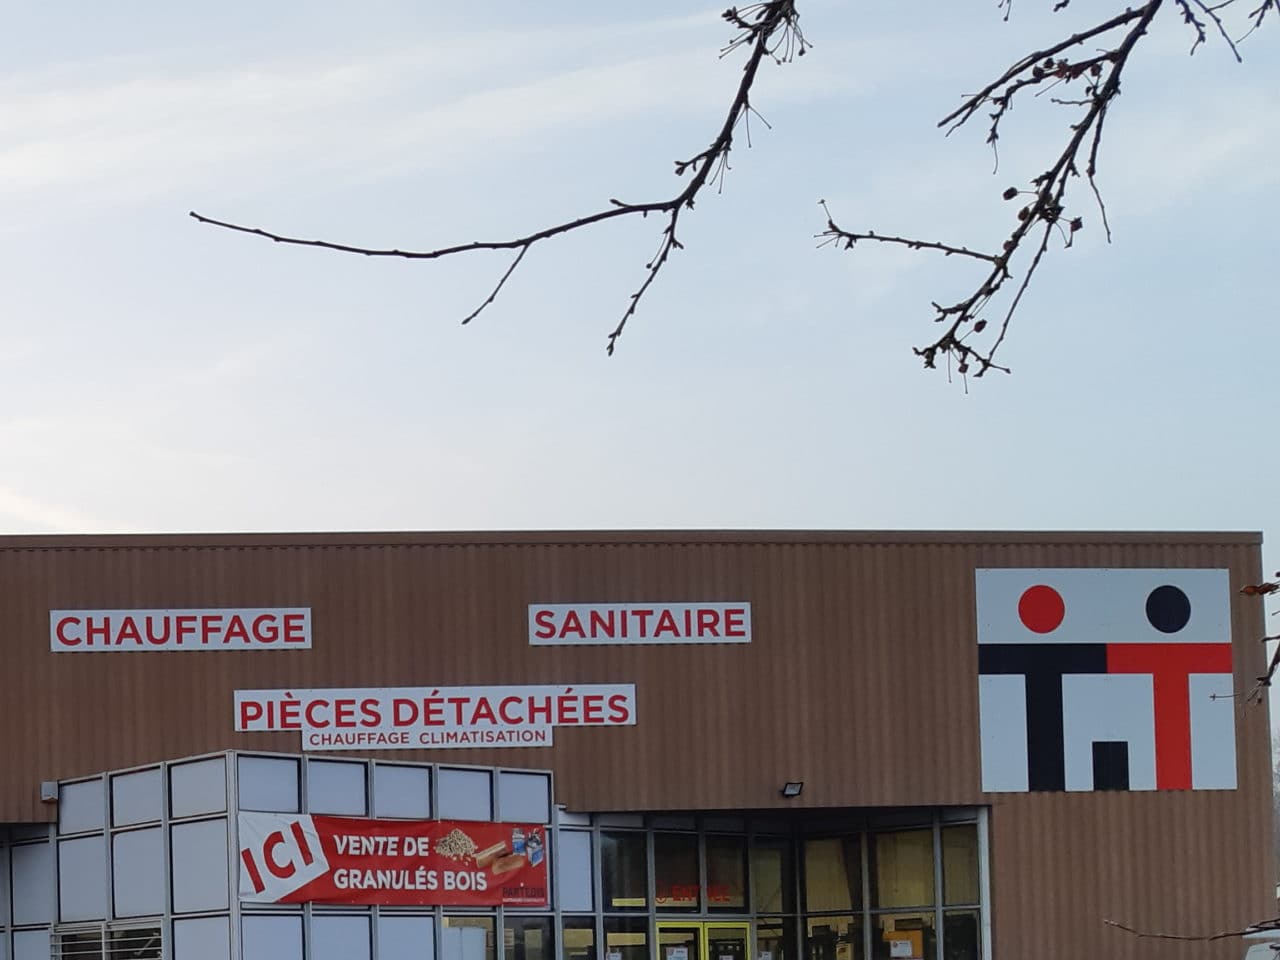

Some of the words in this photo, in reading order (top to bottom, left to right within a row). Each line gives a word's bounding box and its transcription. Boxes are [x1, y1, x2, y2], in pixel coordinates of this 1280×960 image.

[56, 614, 305, 646] CHAUFFAGE
[535, 609, 746, 640] SANITAIRE
[240, 691, 380, 730] PIÈCES
[393, 687, 629, 727] DÉTACHÉES
[309, 731, 410, 745] CHAUFFAGE
[419, 729, 546, 744] CLIMATISATION
[241, 821, 313, 894] ICI
[333, 834, 399, 856] VENTE
[403, 837, 429, 857] DE
[333, 866, 437, 890] GRANULÉS
[444, 871, 487, 891] BOIS
